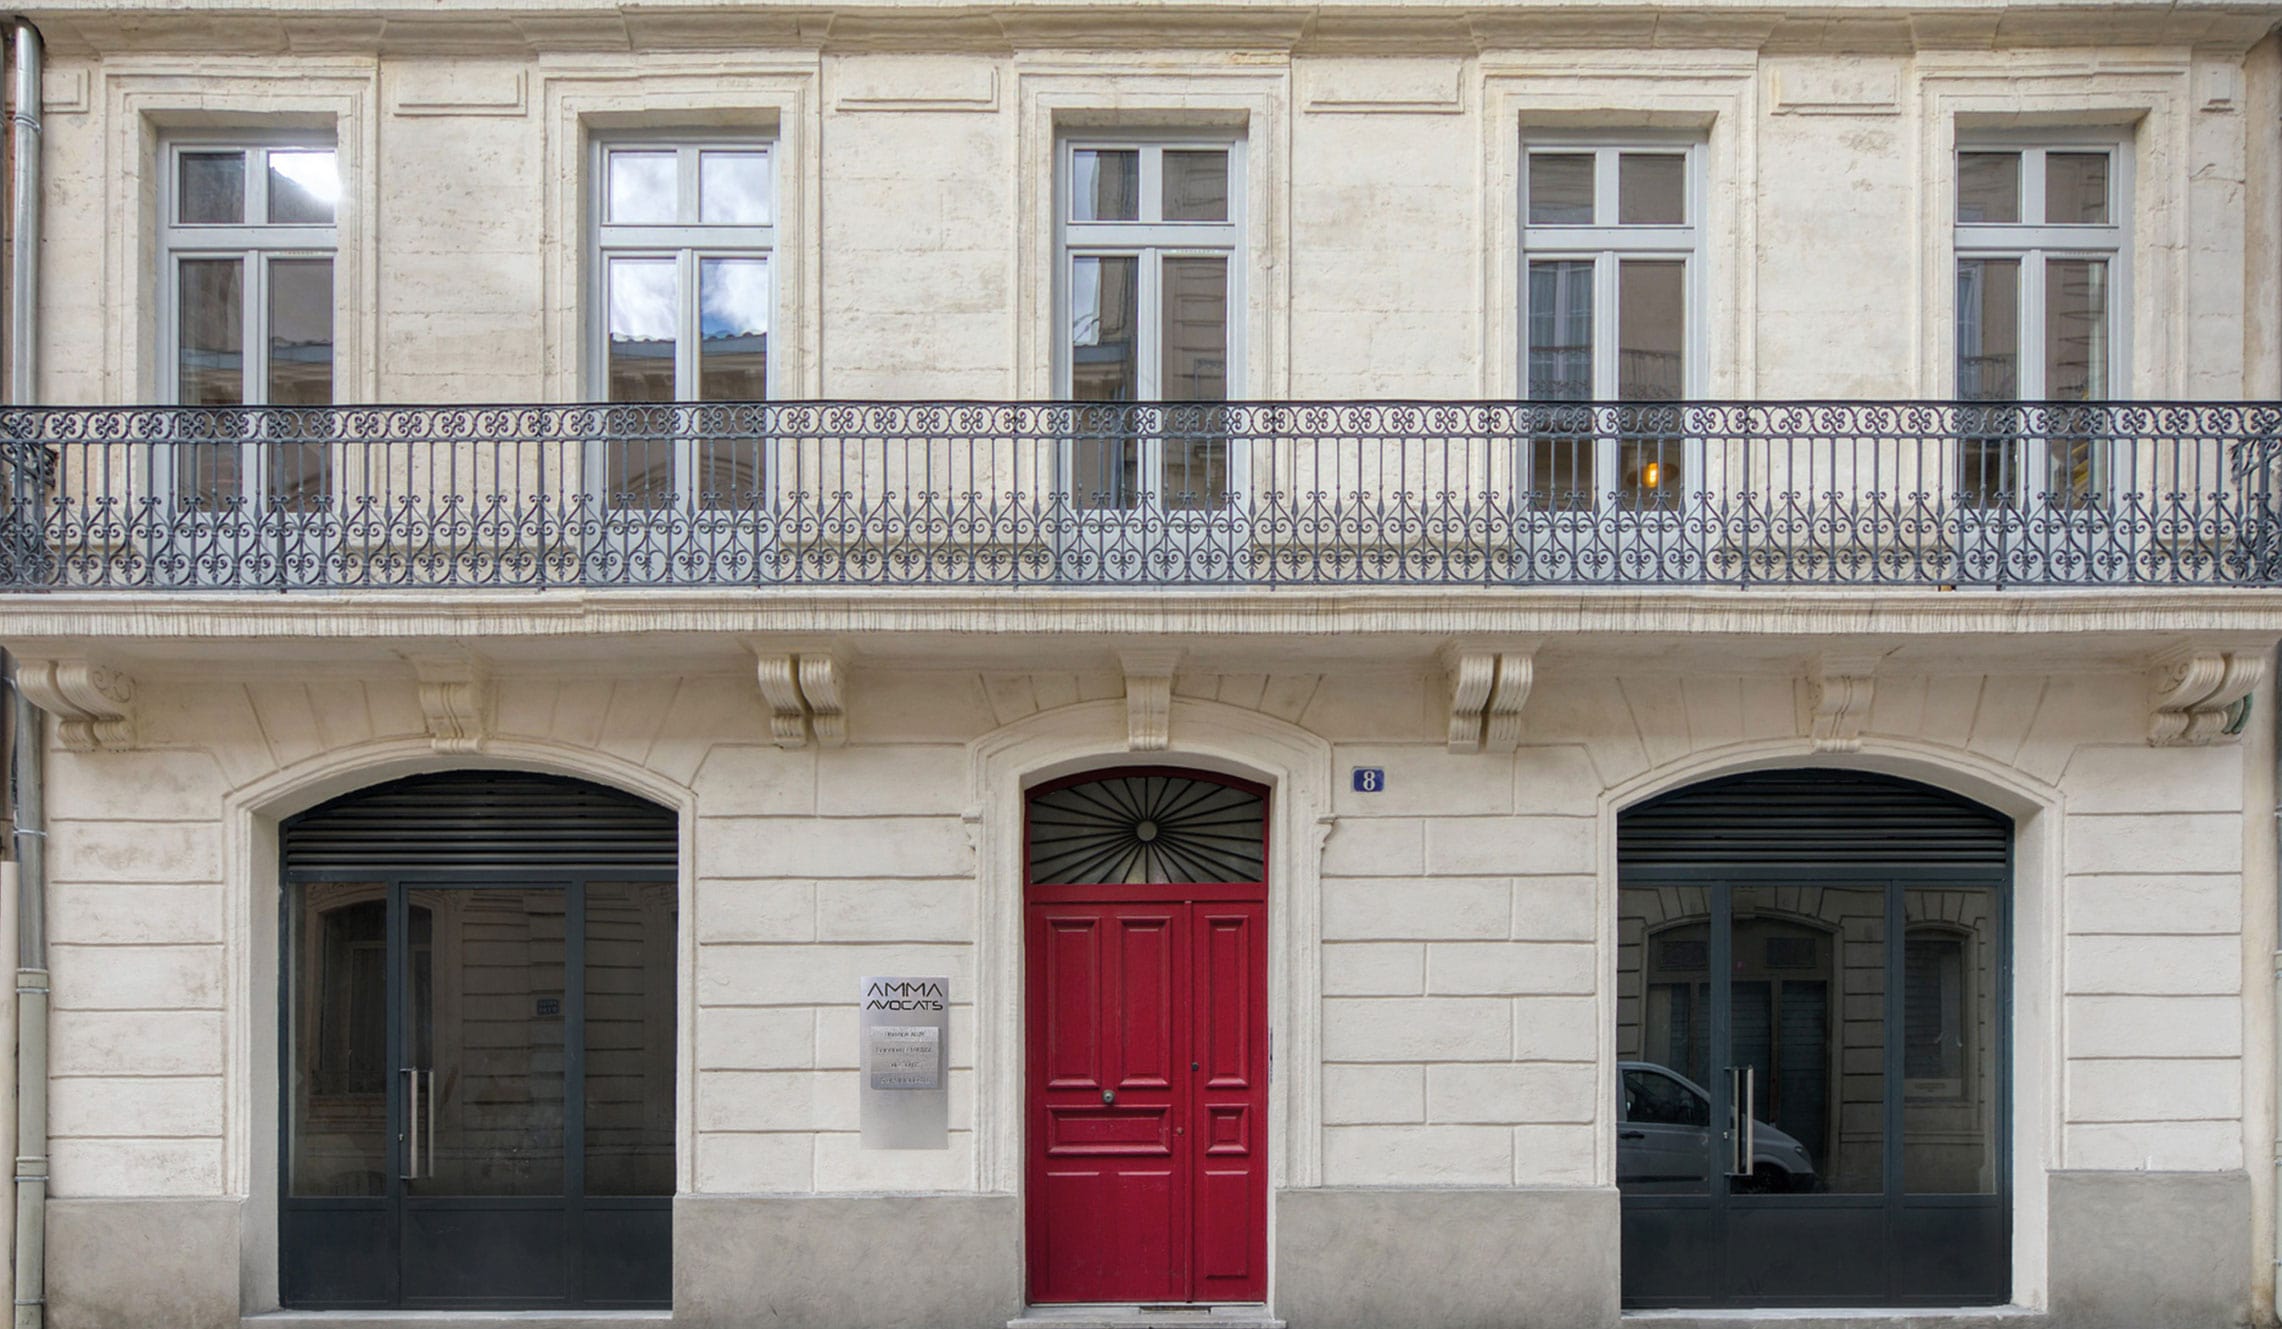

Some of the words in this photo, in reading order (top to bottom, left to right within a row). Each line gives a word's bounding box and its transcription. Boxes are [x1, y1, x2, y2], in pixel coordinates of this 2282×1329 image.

[1363, 770, 1375, 791] 8
[867, 982, 943, 997] AMMA
[866, 1000, 944, 1011] AVOCATS
